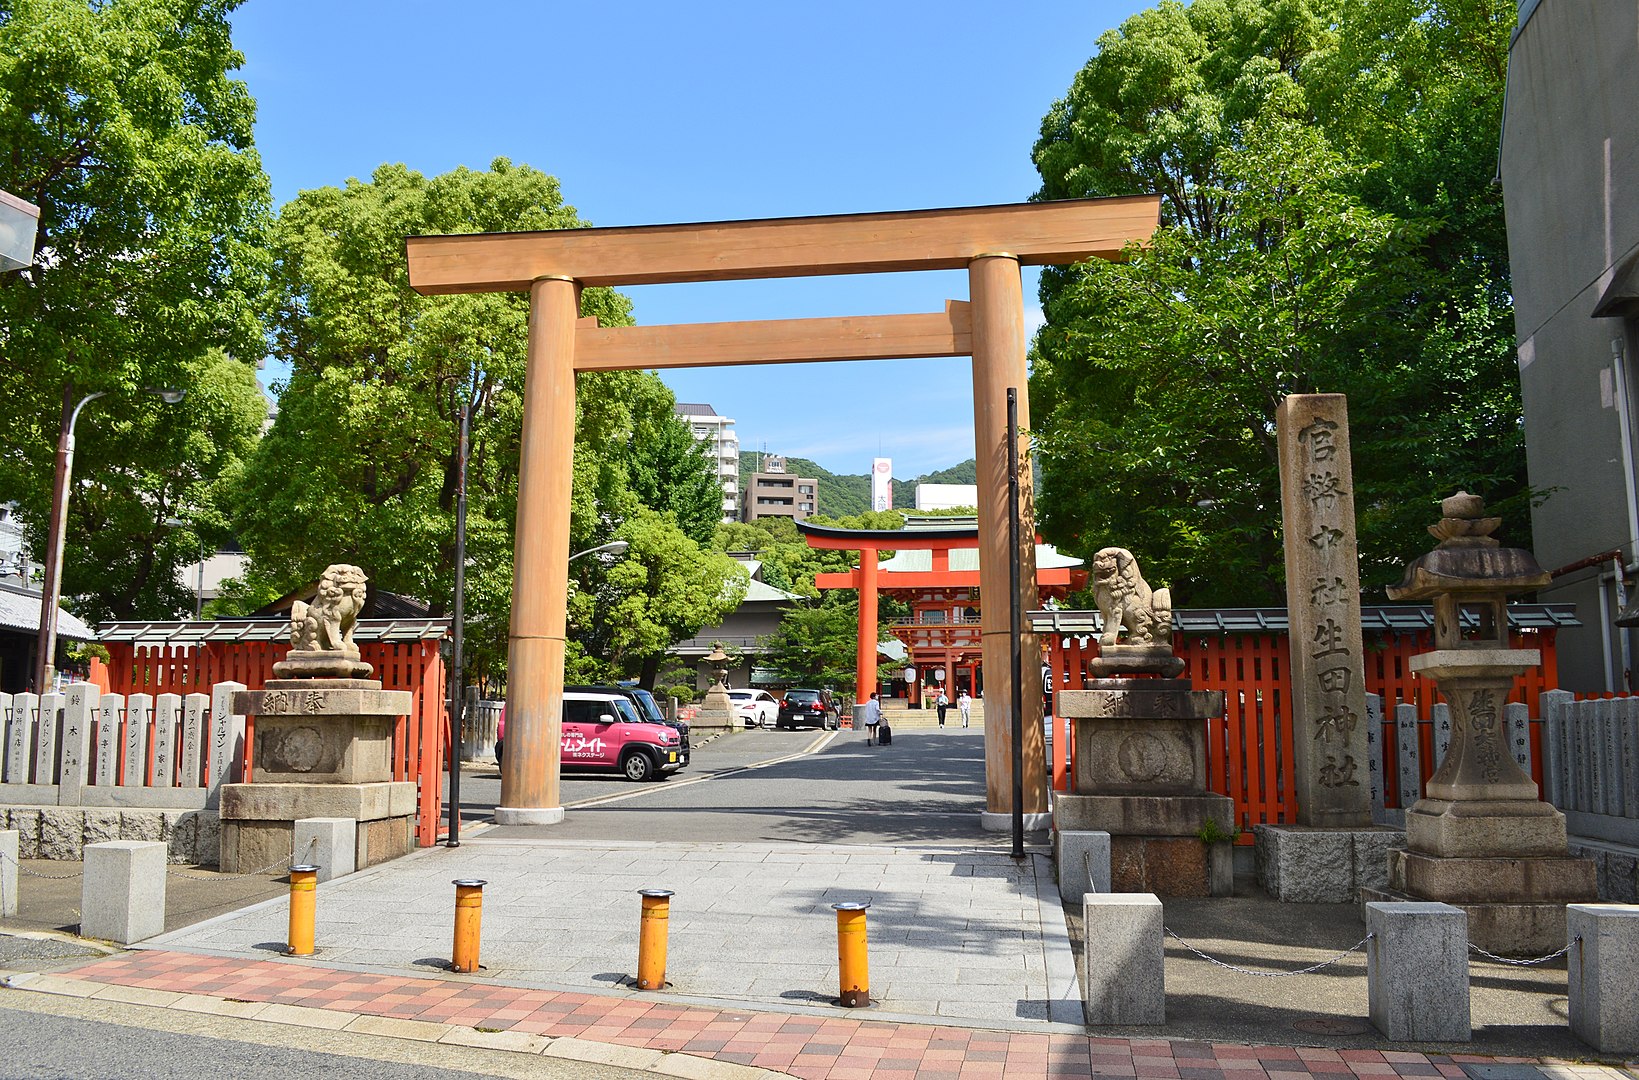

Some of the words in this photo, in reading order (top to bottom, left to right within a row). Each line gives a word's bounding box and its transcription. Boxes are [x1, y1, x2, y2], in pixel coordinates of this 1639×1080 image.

[217, 712, 227, 748] シャルマン
